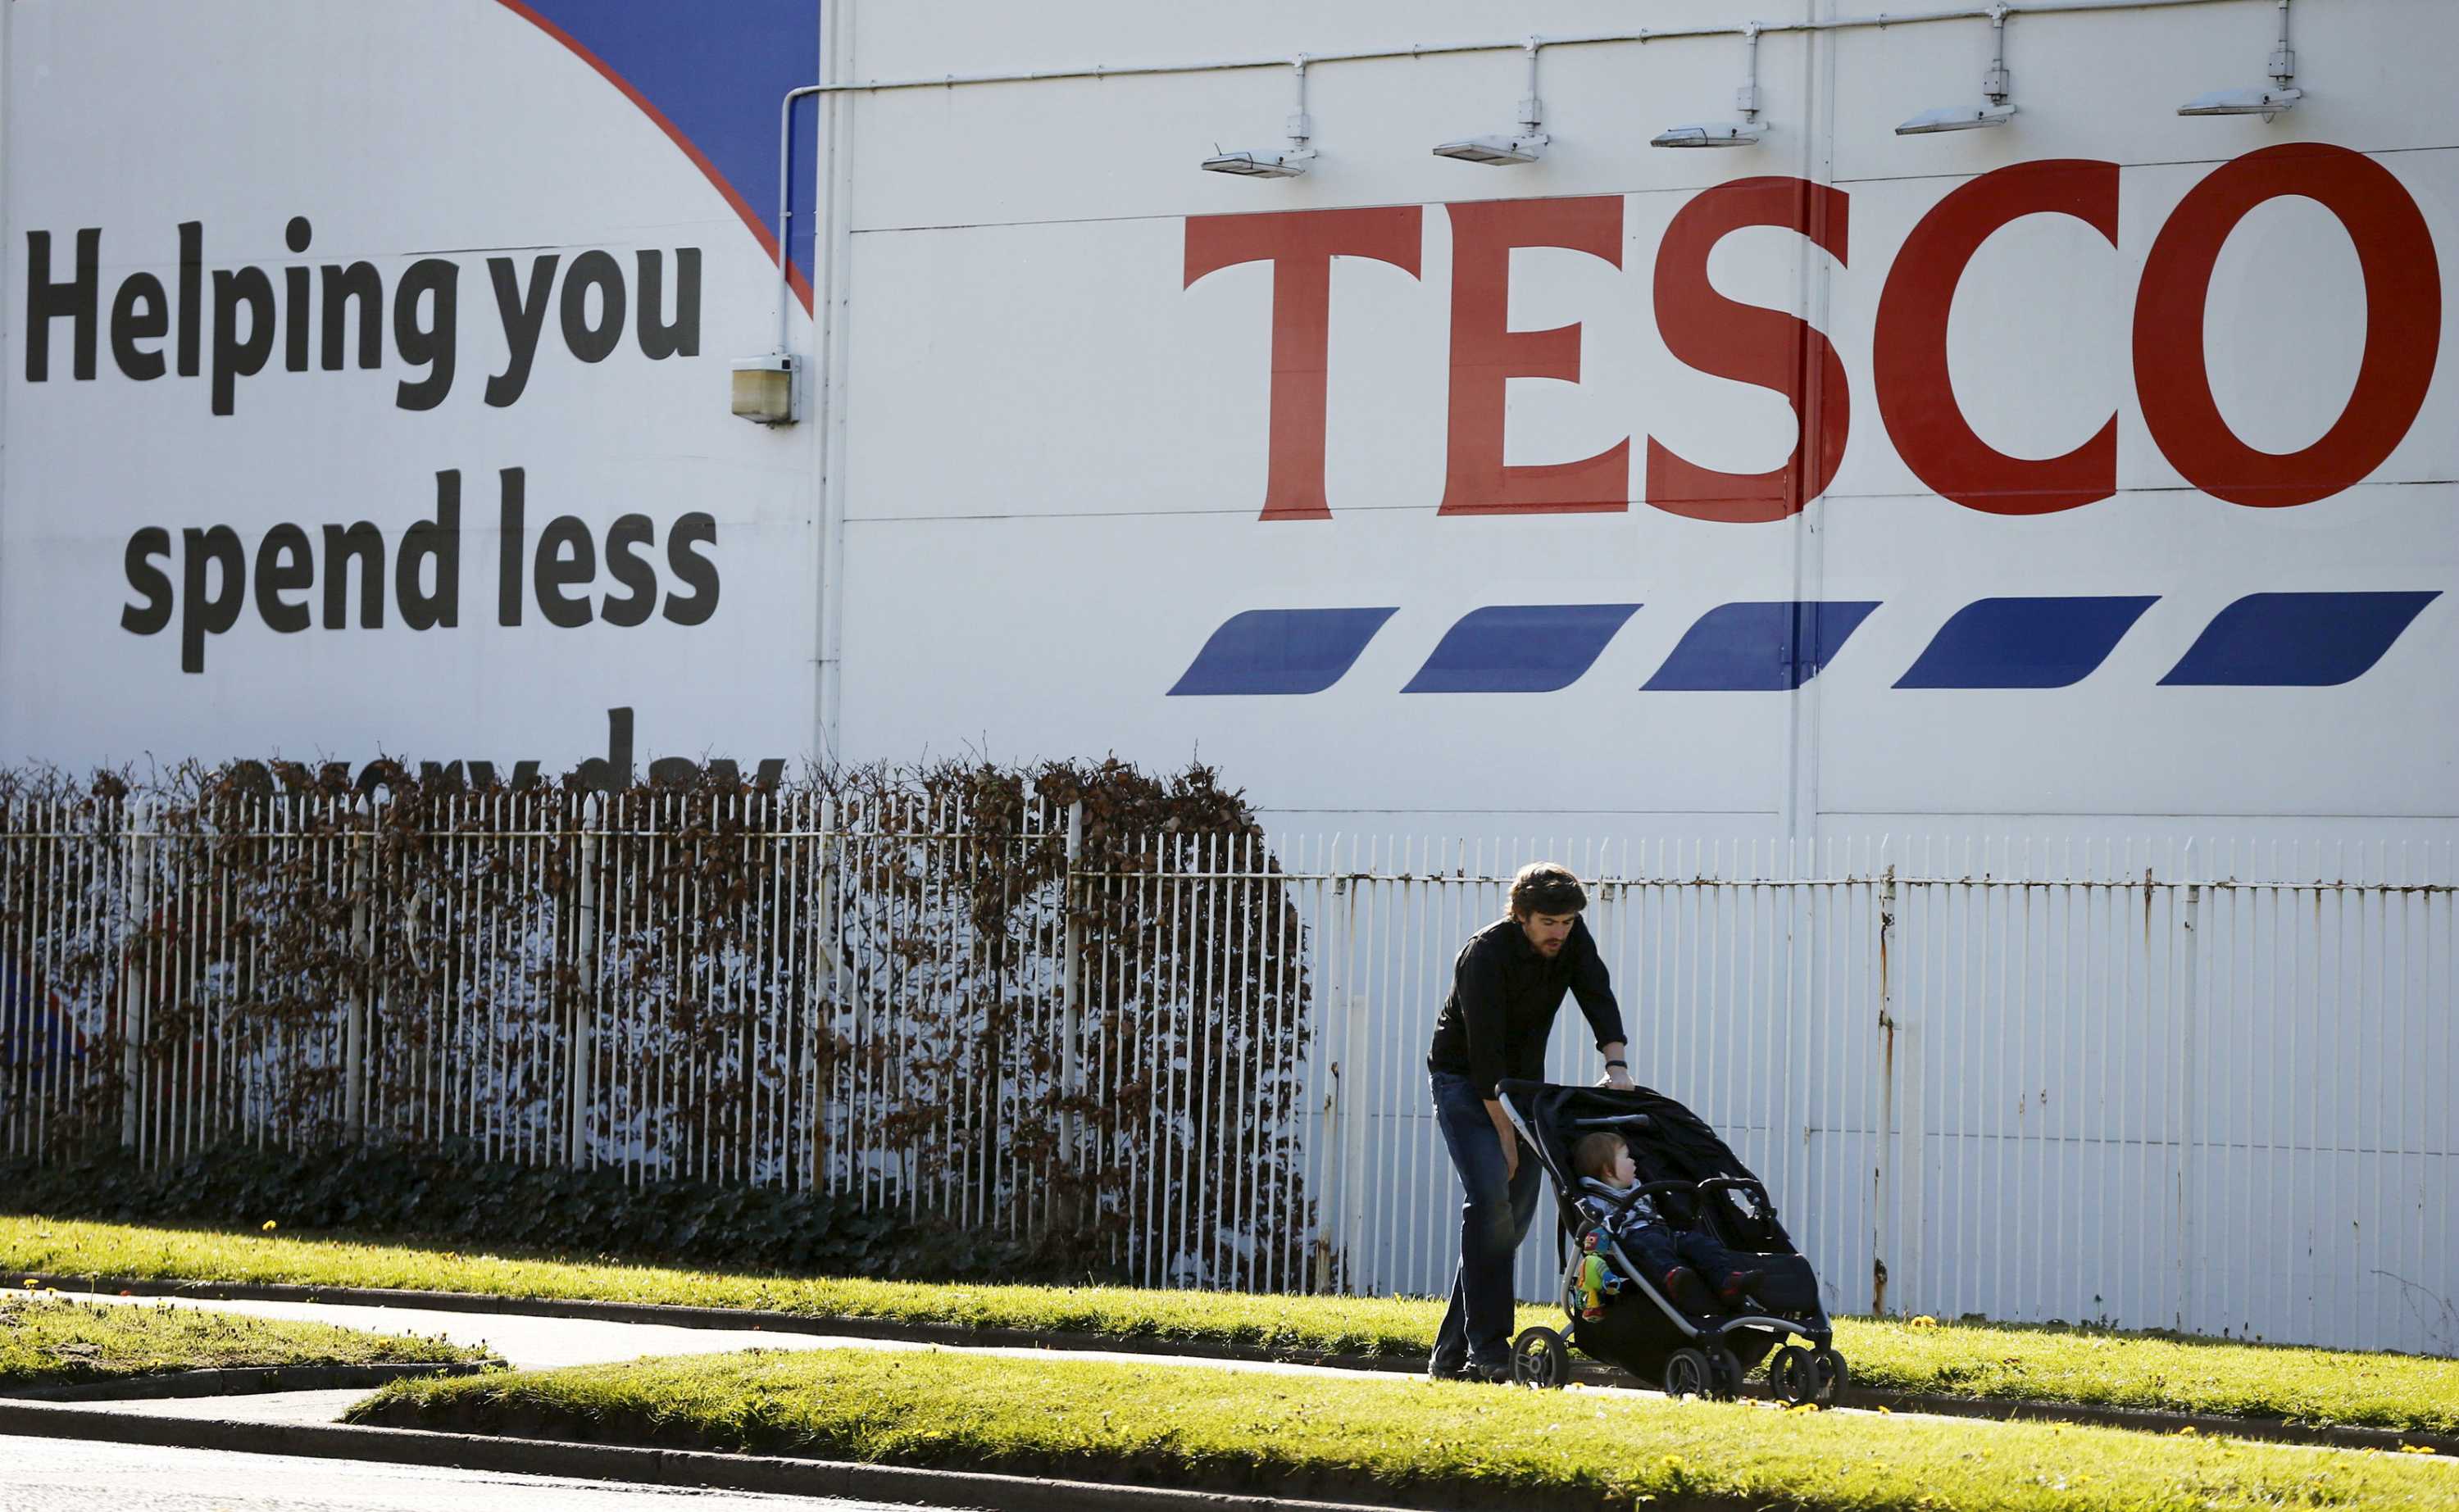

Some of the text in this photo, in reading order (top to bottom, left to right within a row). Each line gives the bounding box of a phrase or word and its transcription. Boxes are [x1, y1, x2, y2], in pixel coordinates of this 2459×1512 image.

[26, 216, 702, 415] Helping you
[1185, 143, 2442, 522] TESCO
[121, 467, 719, 674] spend less
